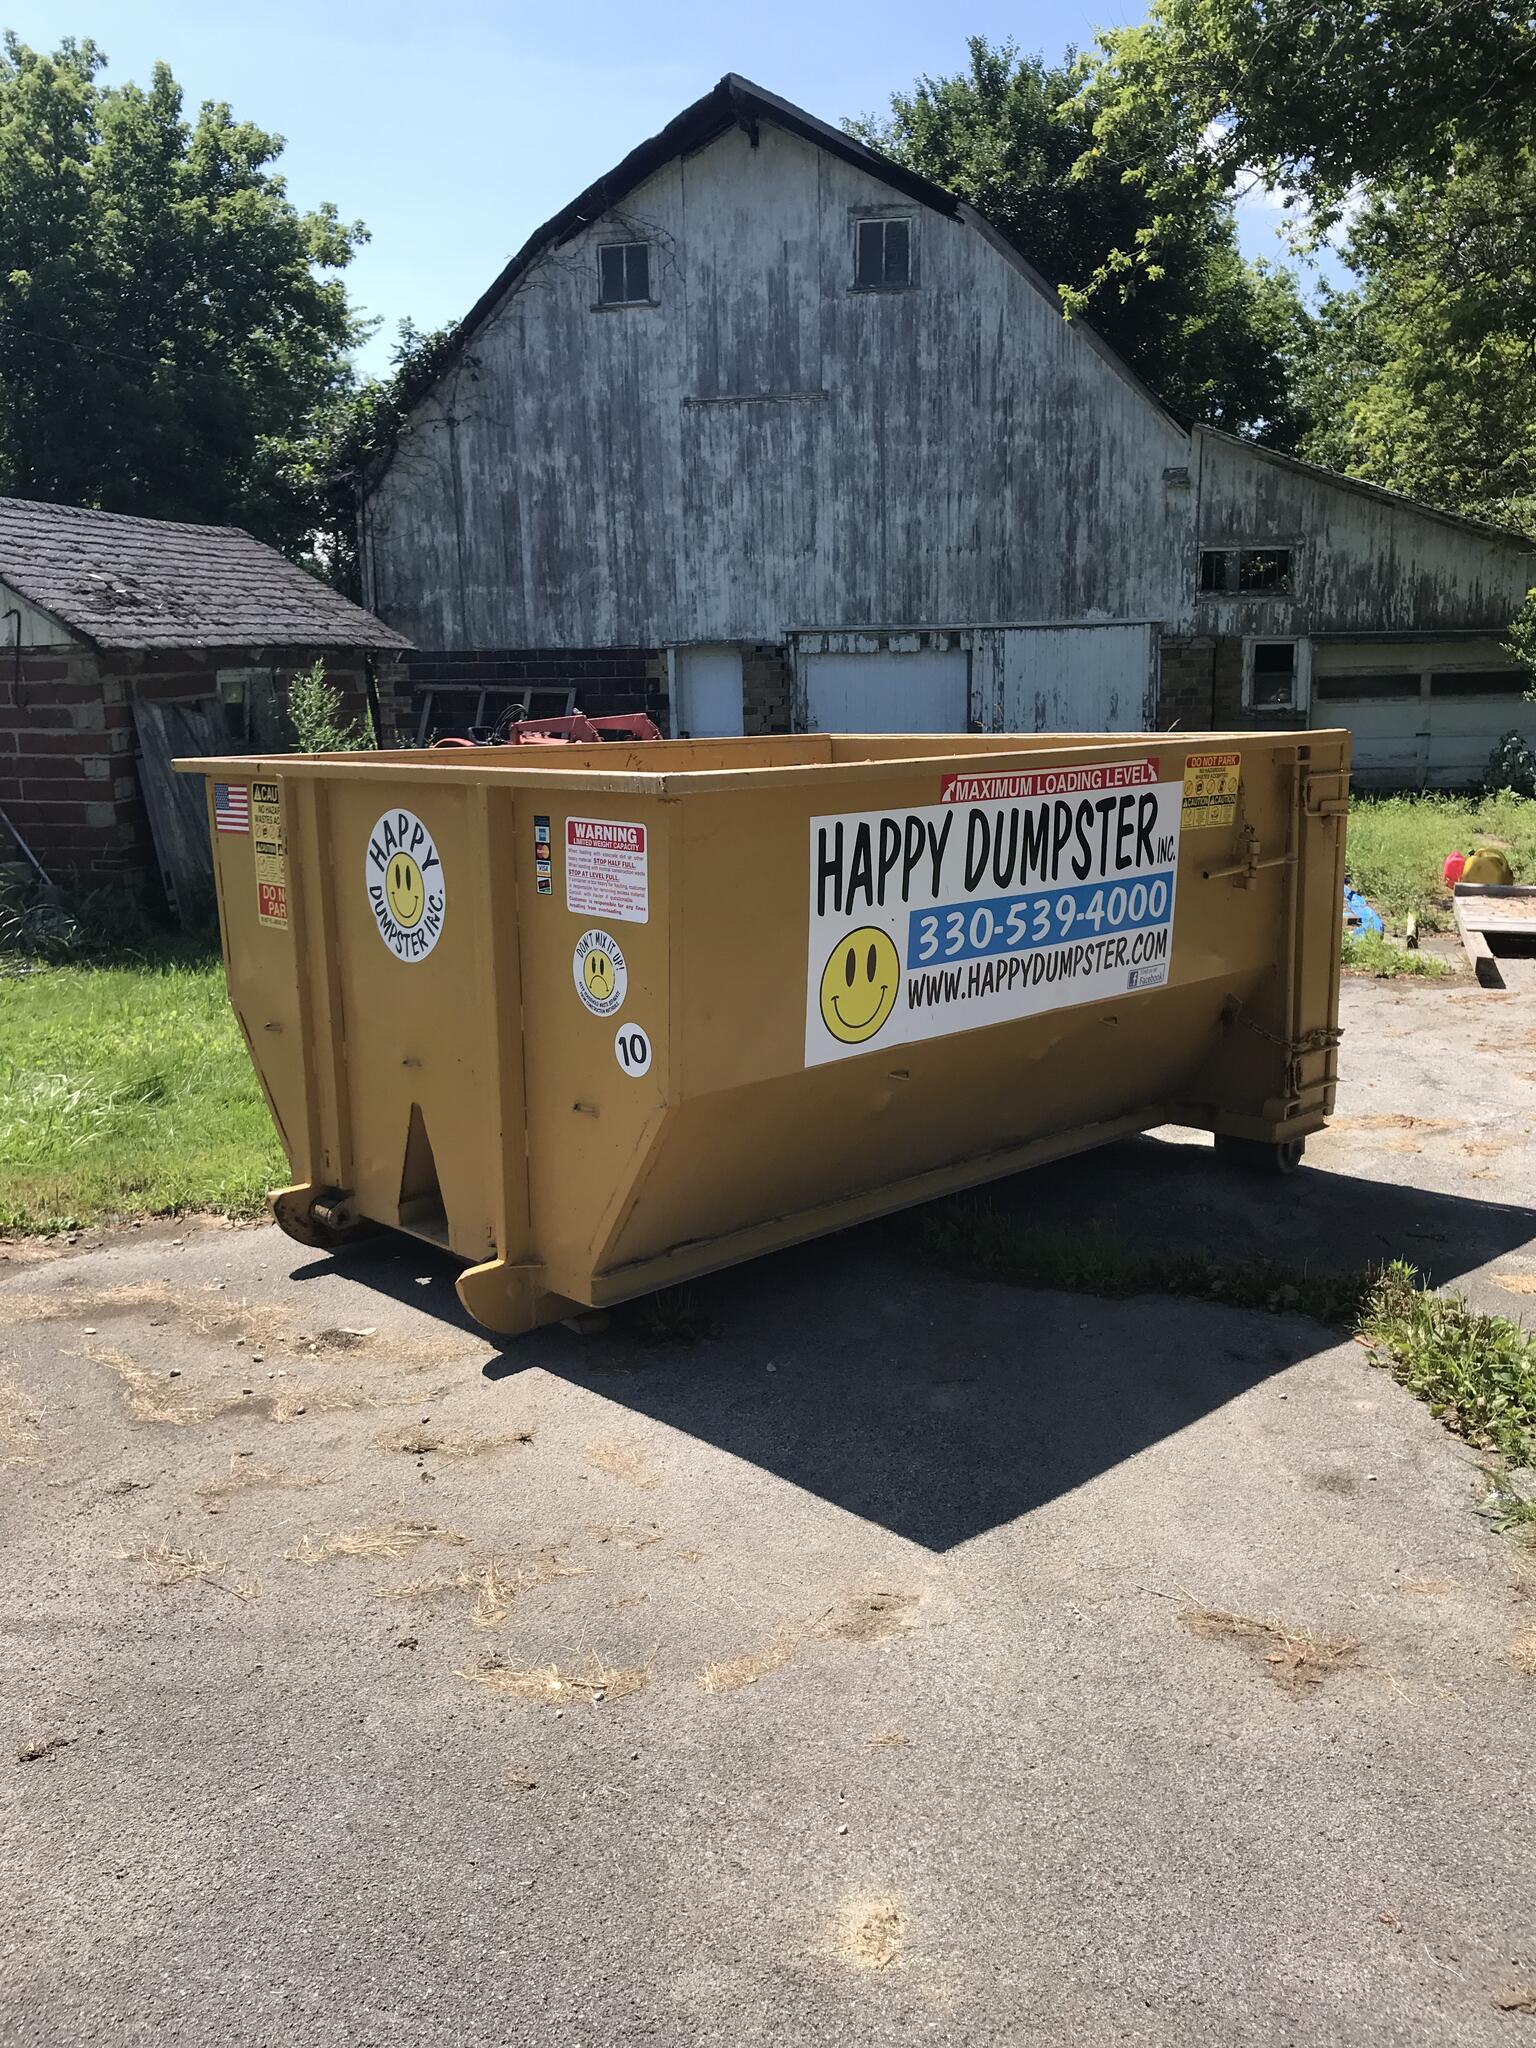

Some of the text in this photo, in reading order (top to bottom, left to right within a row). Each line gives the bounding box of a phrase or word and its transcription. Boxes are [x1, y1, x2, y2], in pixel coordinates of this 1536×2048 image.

[1192, 756, 1236, 767] DO NOT PARK
[956, 763, 1148, 801] MAXIMUM LOADING LEVEL
[369, 813, 439, 872] HAPPY
[574, 823, 637, 844] WARNING
[574, 838, 639, 851] LIMITED WEIGHT CAPACITY
[817, 791, 1176, 917] HAPPY DUMPSTER INC.
[262, 885, 276, 900] DO
[268, 901, 287, 917] PAR
[369, 885, 443, 957] DUMPSTER INC.
[918, 879, 1168, 961] 330-539-4000
[576, 932, 625, 971] DON'T MIX IT UP!
[907, 928, 1167, 1010] WWW.HAPPYDUMPSTER.COM
[1140, 973, 1162, 984] Facebook
[618, 1033, 647, 1067] 10
